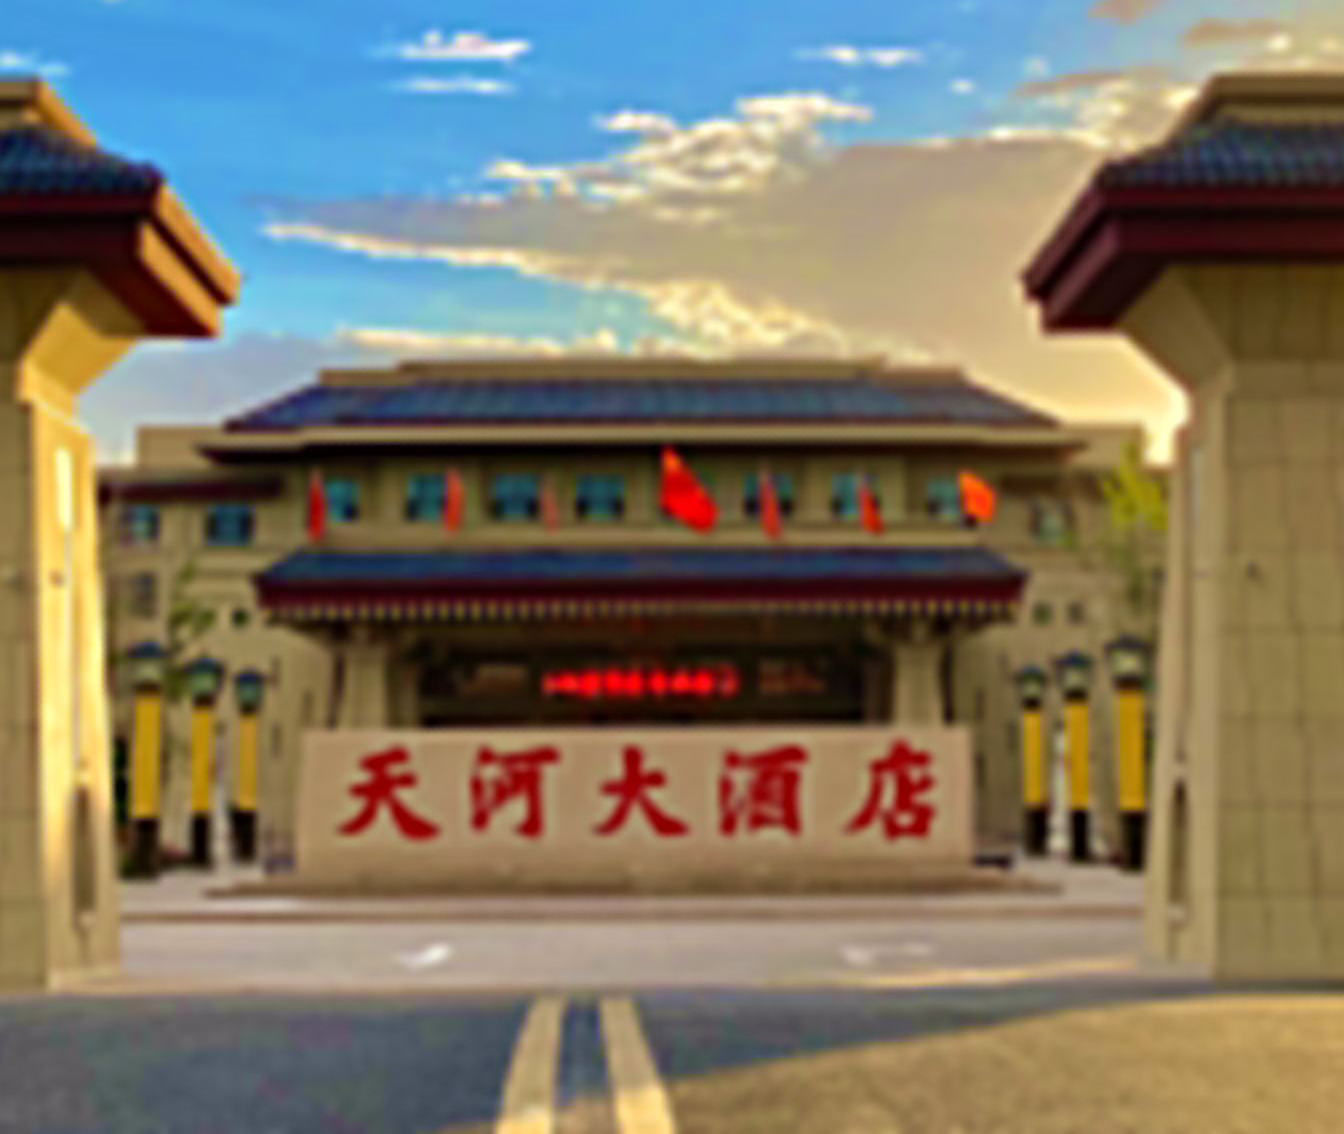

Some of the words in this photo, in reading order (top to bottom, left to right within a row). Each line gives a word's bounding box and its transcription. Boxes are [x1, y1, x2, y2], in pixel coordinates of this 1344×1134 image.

[339, 738, 937, 842] 天河大酒店
